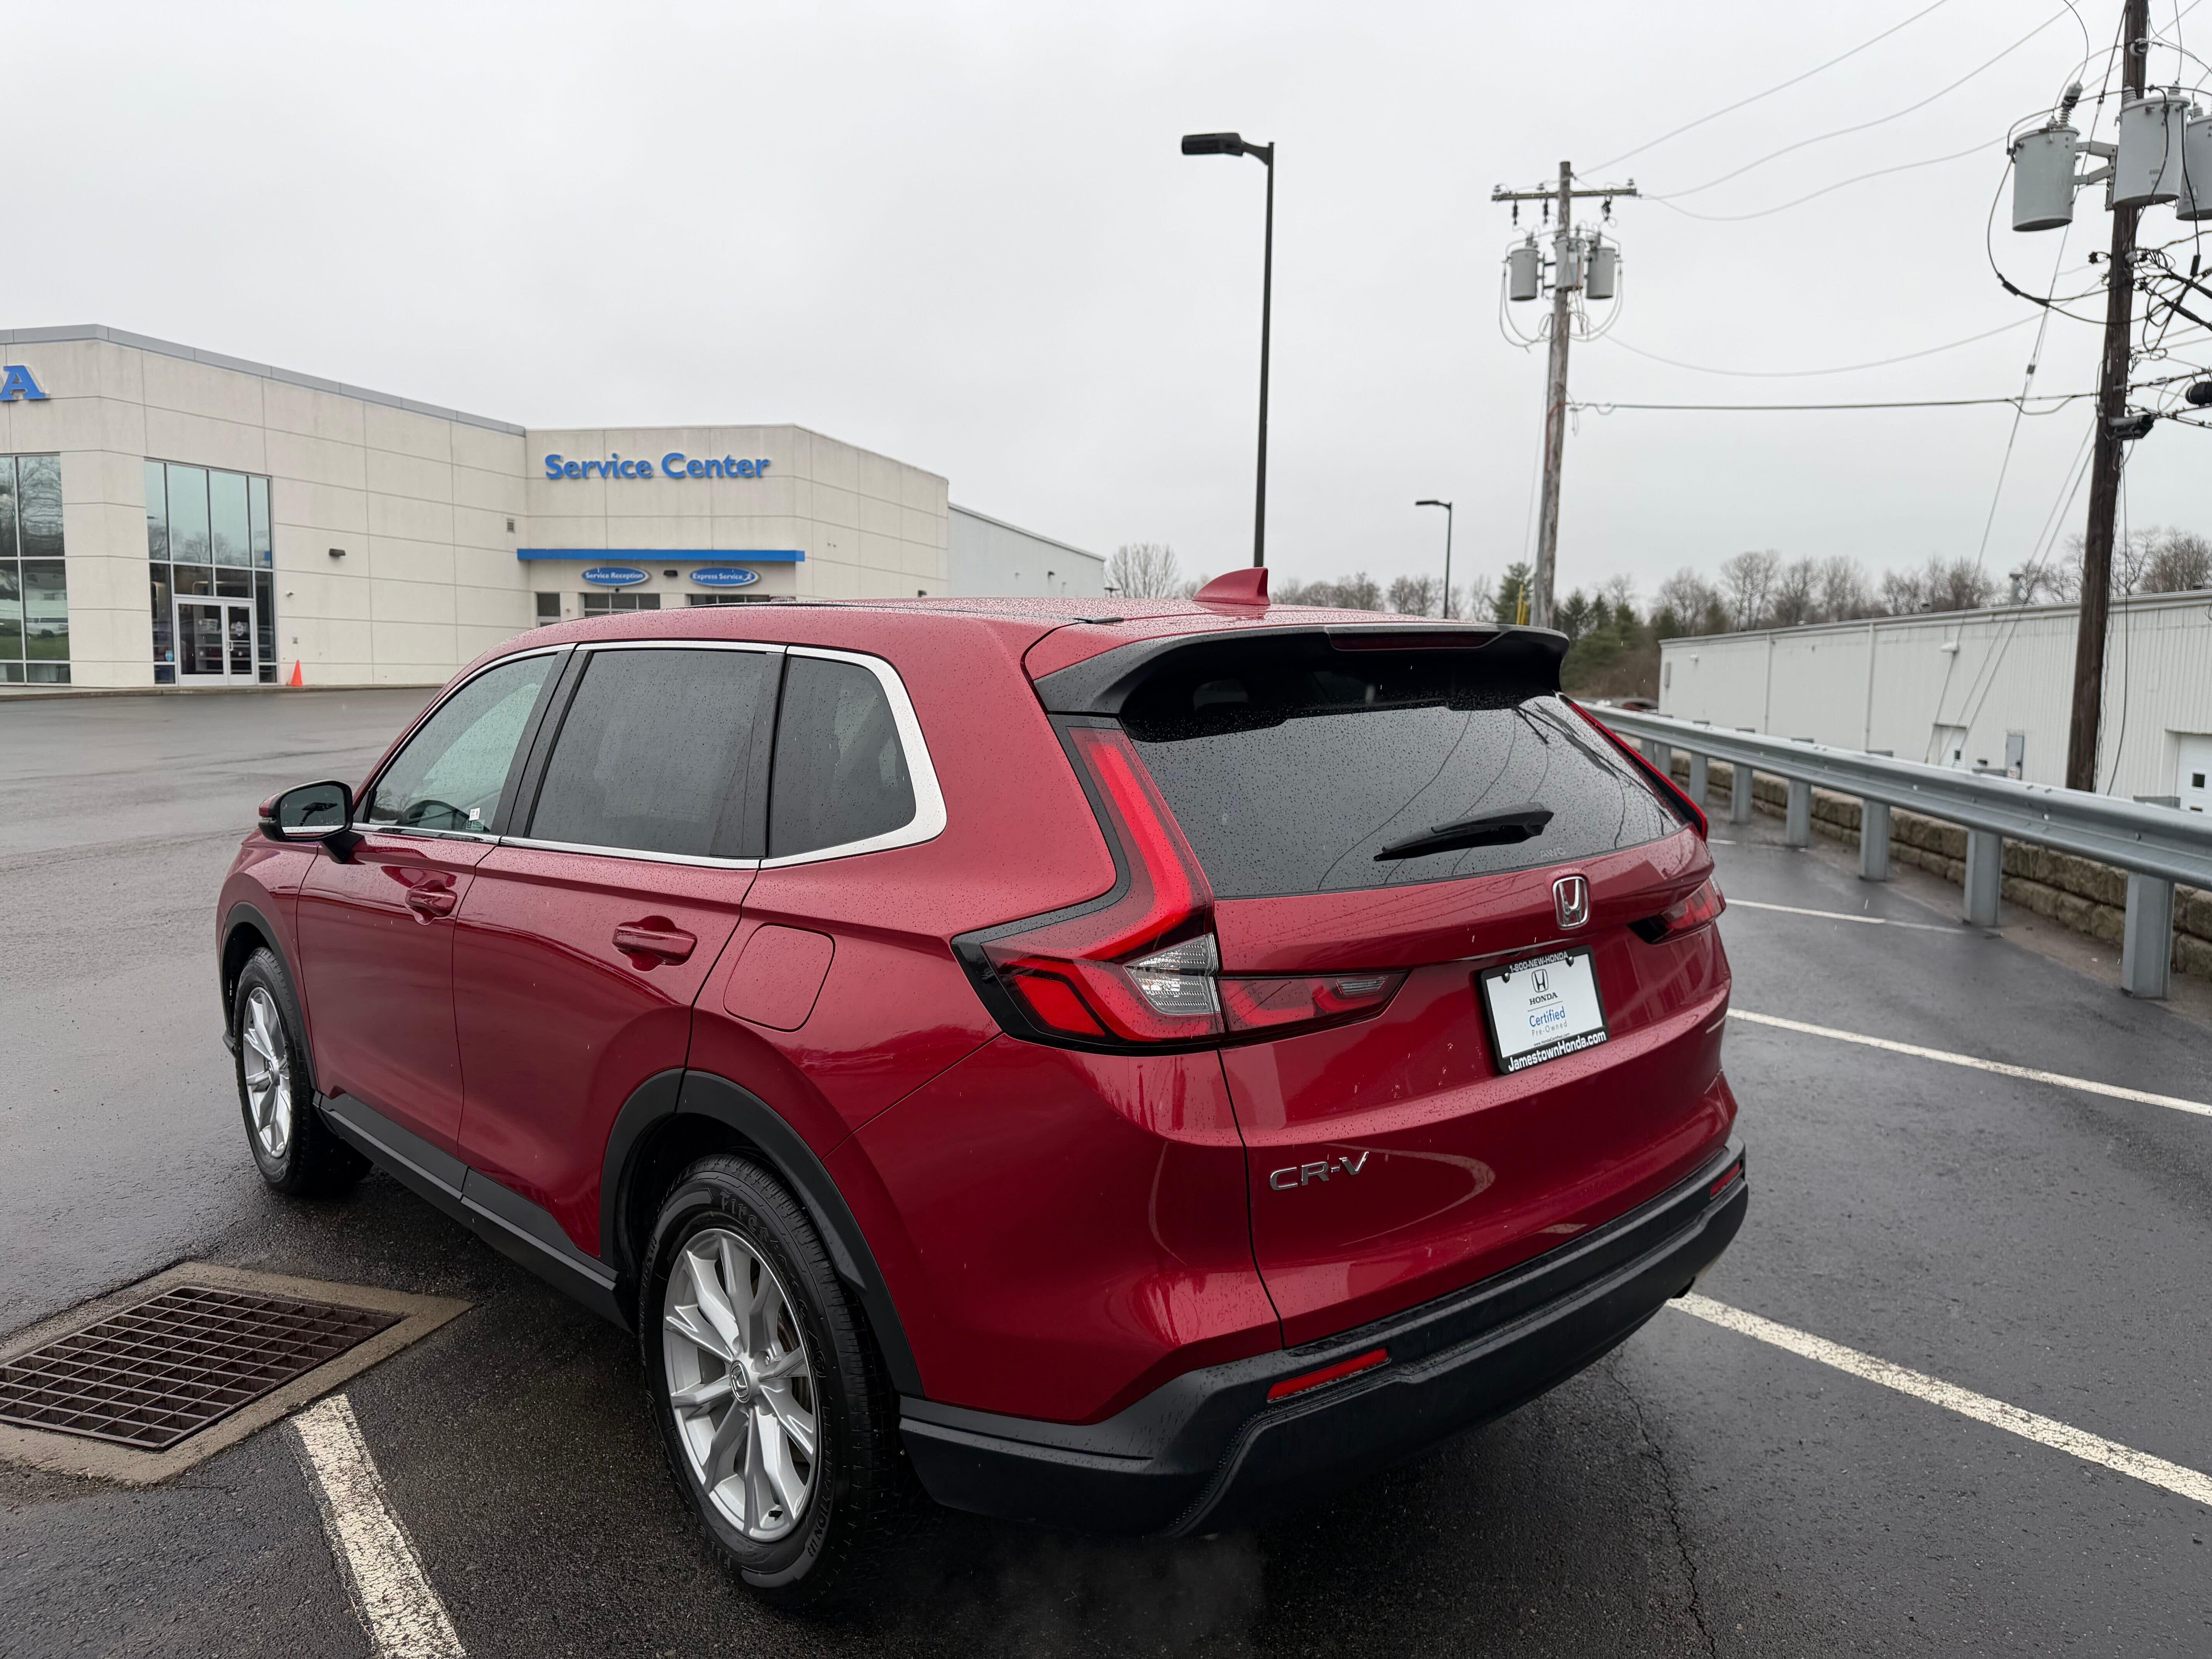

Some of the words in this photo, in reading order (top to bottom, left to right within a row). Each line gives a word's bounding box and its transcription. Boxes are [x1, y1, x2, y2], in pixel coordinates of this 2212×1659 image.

[544, 453, 652, 479] Service
[661, 453, 770, 479] Center
[611, 572, 643, 580] Reception
[693, 572, 718, 580] Express
[1540, 847, 1566, 859] AWD
[1510, 951, 1568, 973] 1-800-NEW-HONDA
[1529, 992, 1558, 1005] HONDA
[1529, 1006, 1565, 1027] Certified
[1532, 1020, 1567, 1037] Pre-Owned
[1508, 1031, 1606, 1072] JamestownHonda.com
[1270, 1151, 1369, 1191] CR-V
